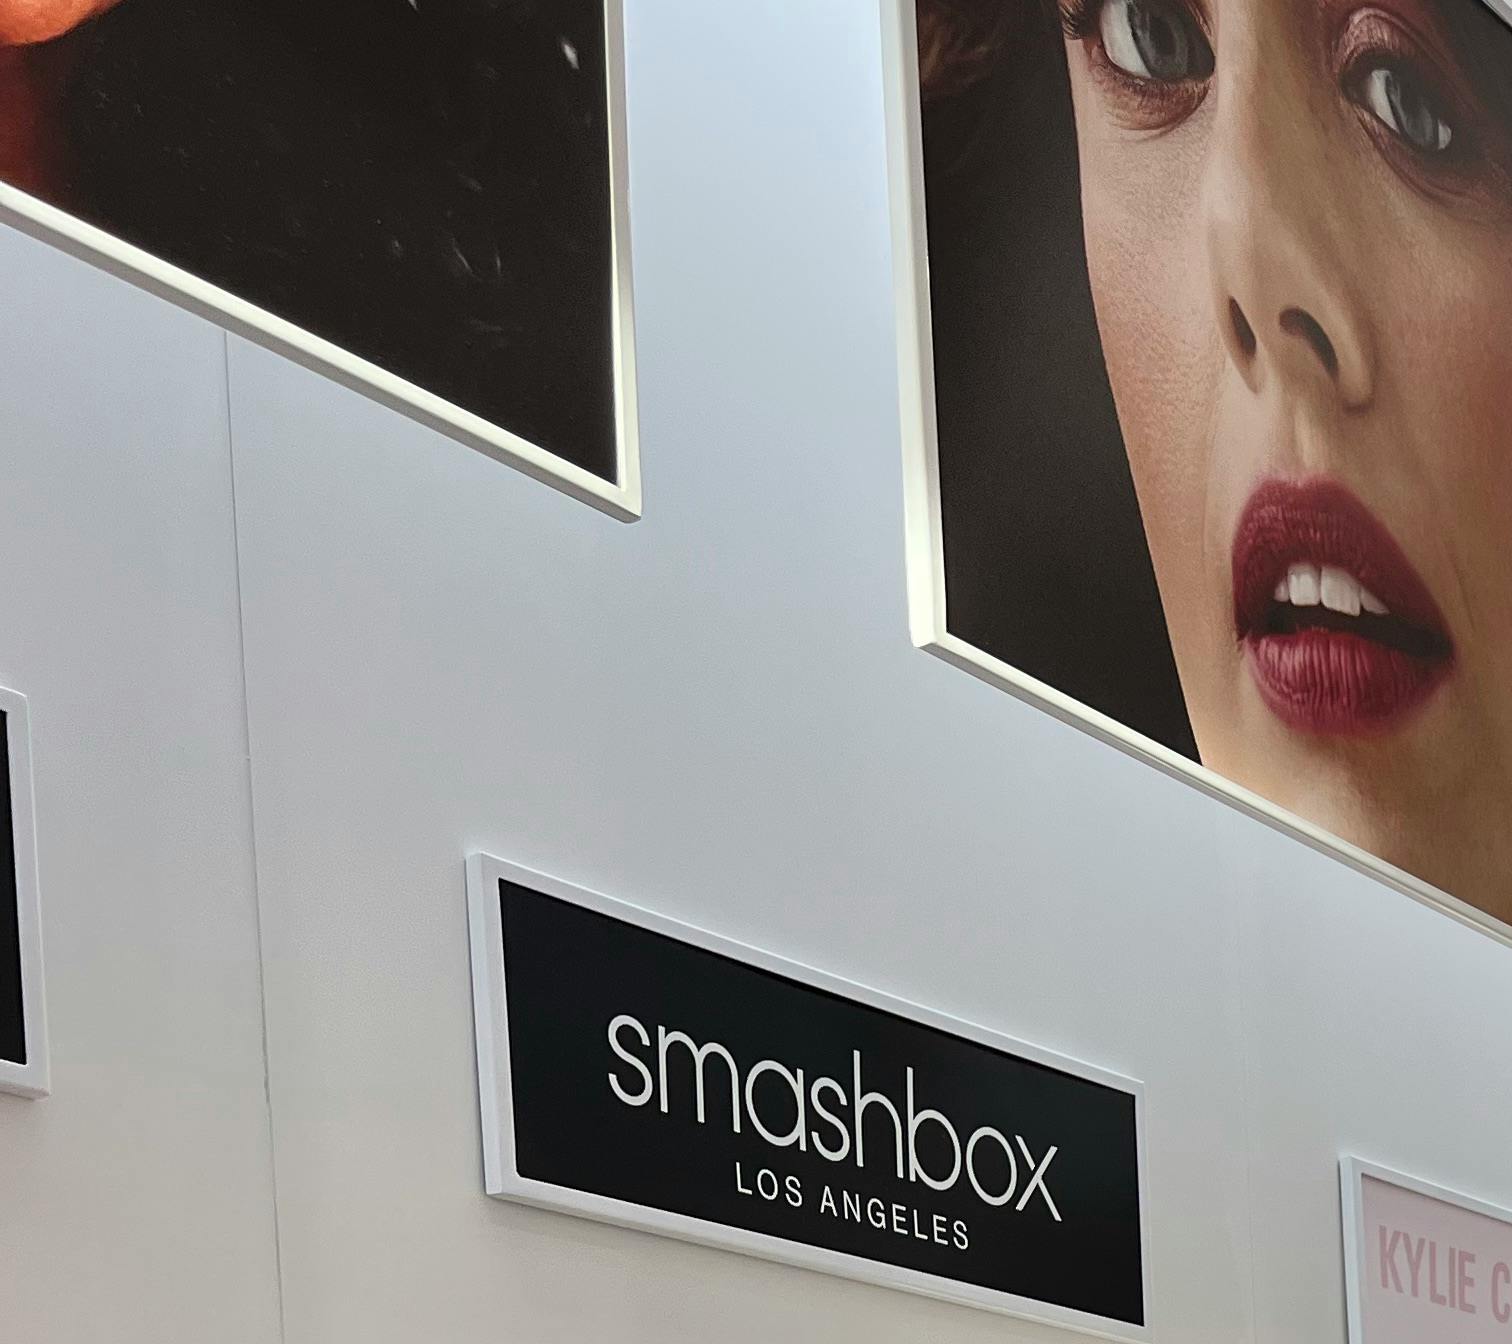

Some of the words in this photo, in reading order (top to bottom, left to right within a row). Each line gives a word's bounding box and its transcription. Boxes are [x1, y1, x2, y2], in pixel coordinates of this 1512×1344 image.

[607, 1015, 1062, 1222] smashbox
[736, 1161, 803, 1208] LOS
[820, 1185, 969, 1250] ANGELES
[1378, 1225, 1476, 1314] KYLIE
